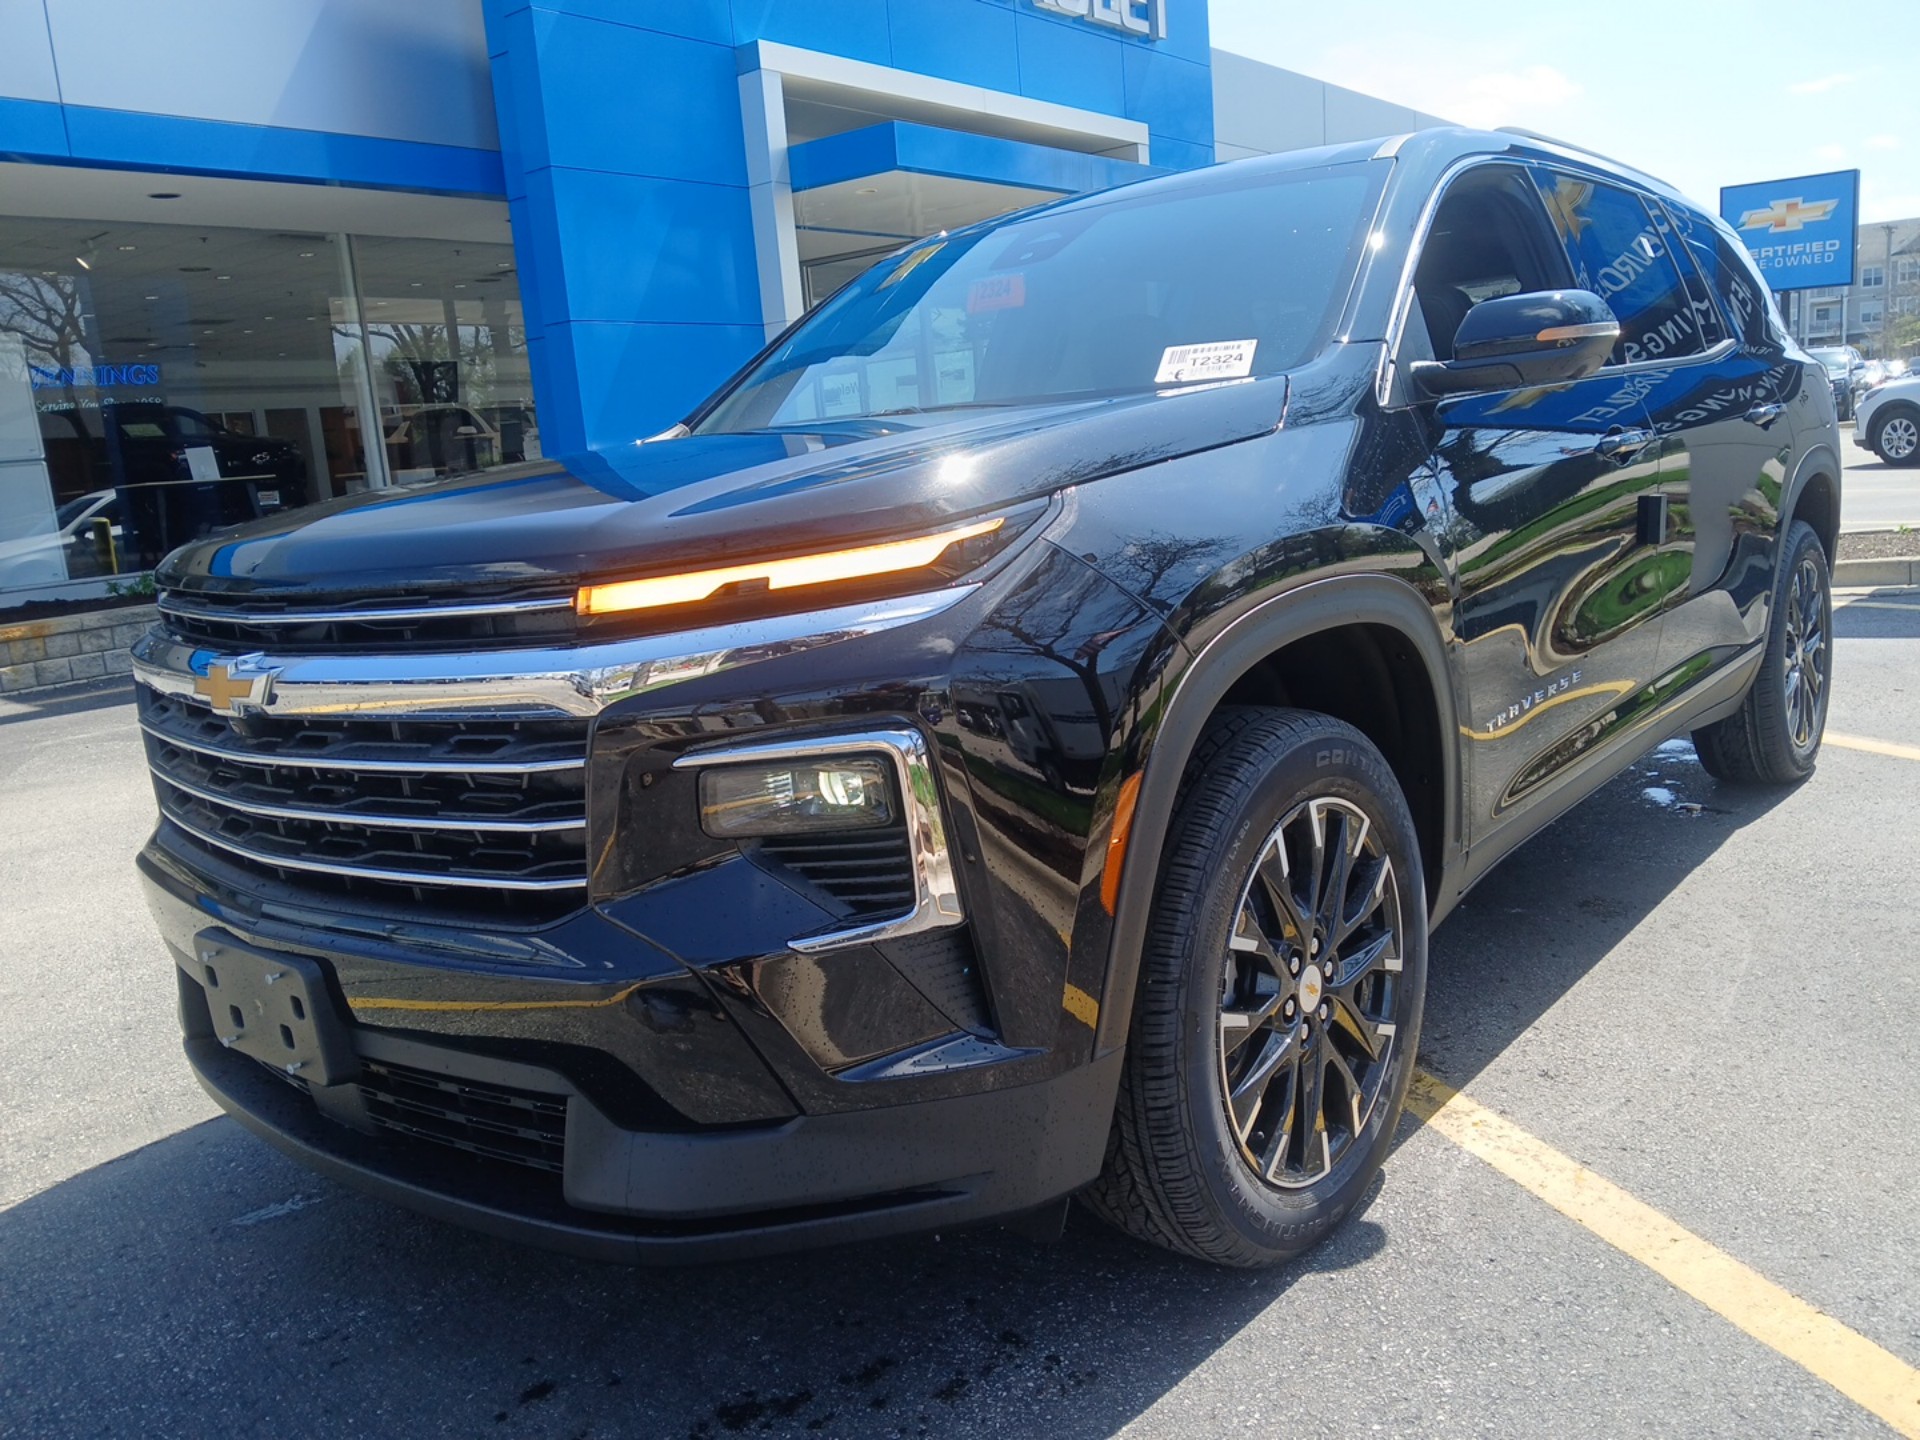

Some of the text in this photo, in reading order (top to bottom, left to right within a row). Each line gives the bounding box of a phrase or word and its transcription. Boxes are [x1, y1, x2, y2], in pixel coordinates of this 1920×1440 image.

[1749, 239, 1840, 259] ERTIFIED
[1759, 252, 1834, 269] E-OWNED
[1190, 353, 1244, 366] T2324
[1486, 671, 1582, 732] TRAVERSE
